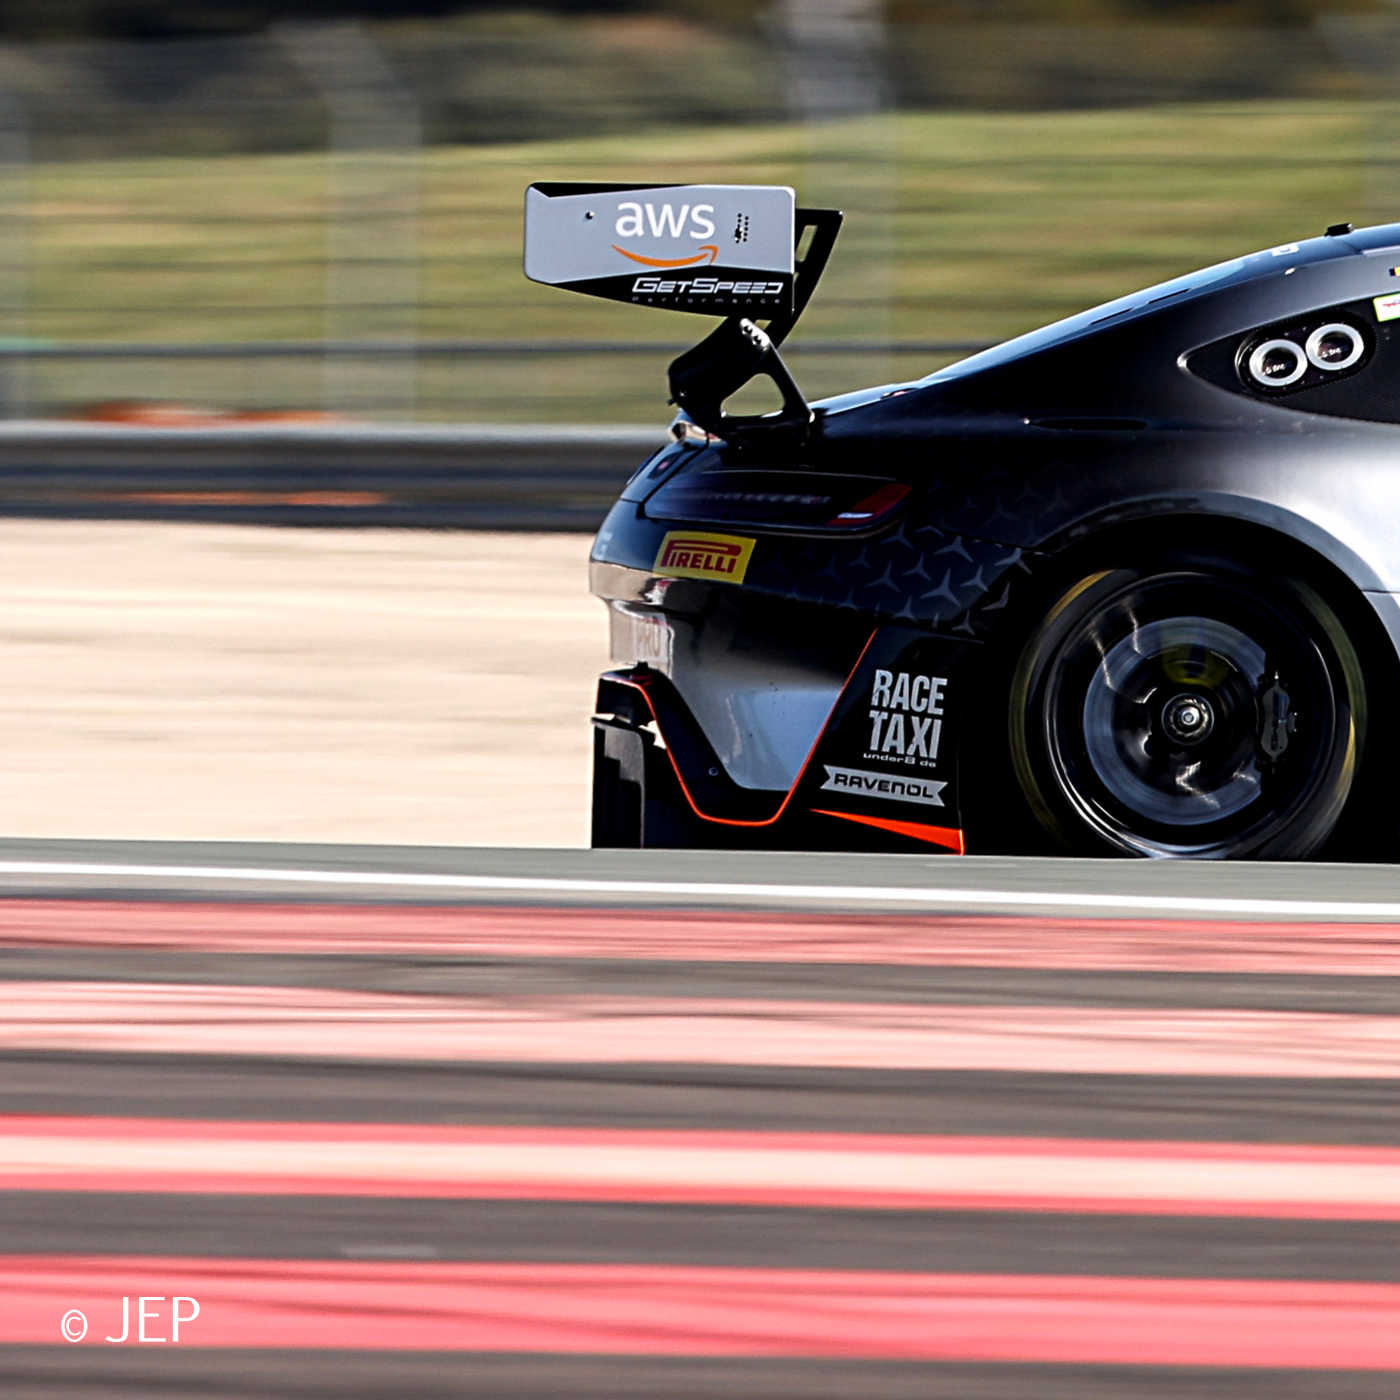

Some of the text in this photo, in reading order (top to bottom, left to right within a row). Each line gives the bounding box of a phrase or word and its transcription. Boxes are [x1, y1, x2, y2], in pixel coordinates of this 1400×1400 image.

[615, 201, 715, 239] aws
[660, 540, 742, 573] PIRELLI
[871, 669, 948, 715] RACE
[869, 710, 942, 759] TAXI
[834, 773, 934, 799] RAVENOL
